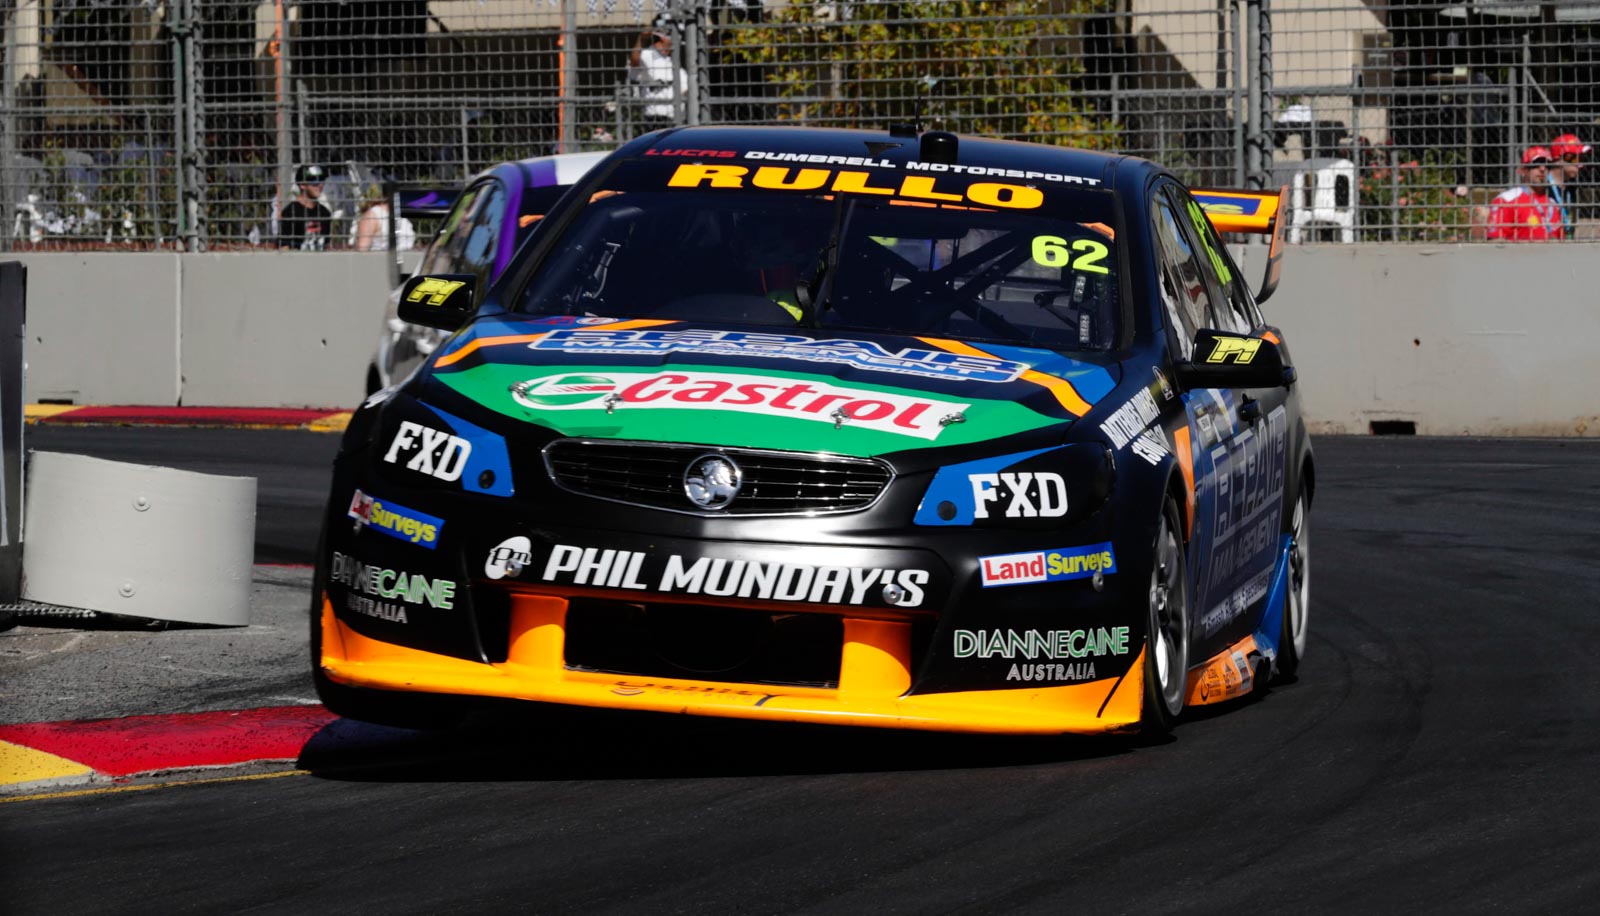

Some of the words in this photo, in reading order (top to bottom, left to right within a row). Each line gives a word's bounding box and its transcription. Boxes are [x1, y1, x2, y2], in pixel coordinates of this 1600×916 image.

[645, 148, 737, 158] LUCAS
[744, 149, 897, 169] DUMBRELL
[905, 160, 1101, 186] MOTORSPORT
[667, 163, 1044, 209] RULLO
[1031, 235, 1109, 275] 62
[548, 329, 1023, 373] REPAIR
[562, 340, 989, 375] MANAGEMENT
[619, 374, 933, 430] Castrol
[1099, 401, 1146, 451] BATTERIES
[370, 501, 437, 543] Surveys
[543, 544, 647, 590] PHIL
[659, 554, 929, 607] MUNDAY'S
[984, 554, 1044, 581] Land
[1047, 550, 1113, 576] Surveys
[347, 593, 408, 624] USTRALIA
[1006, 662, 1096, 682] AUSTRALIA
